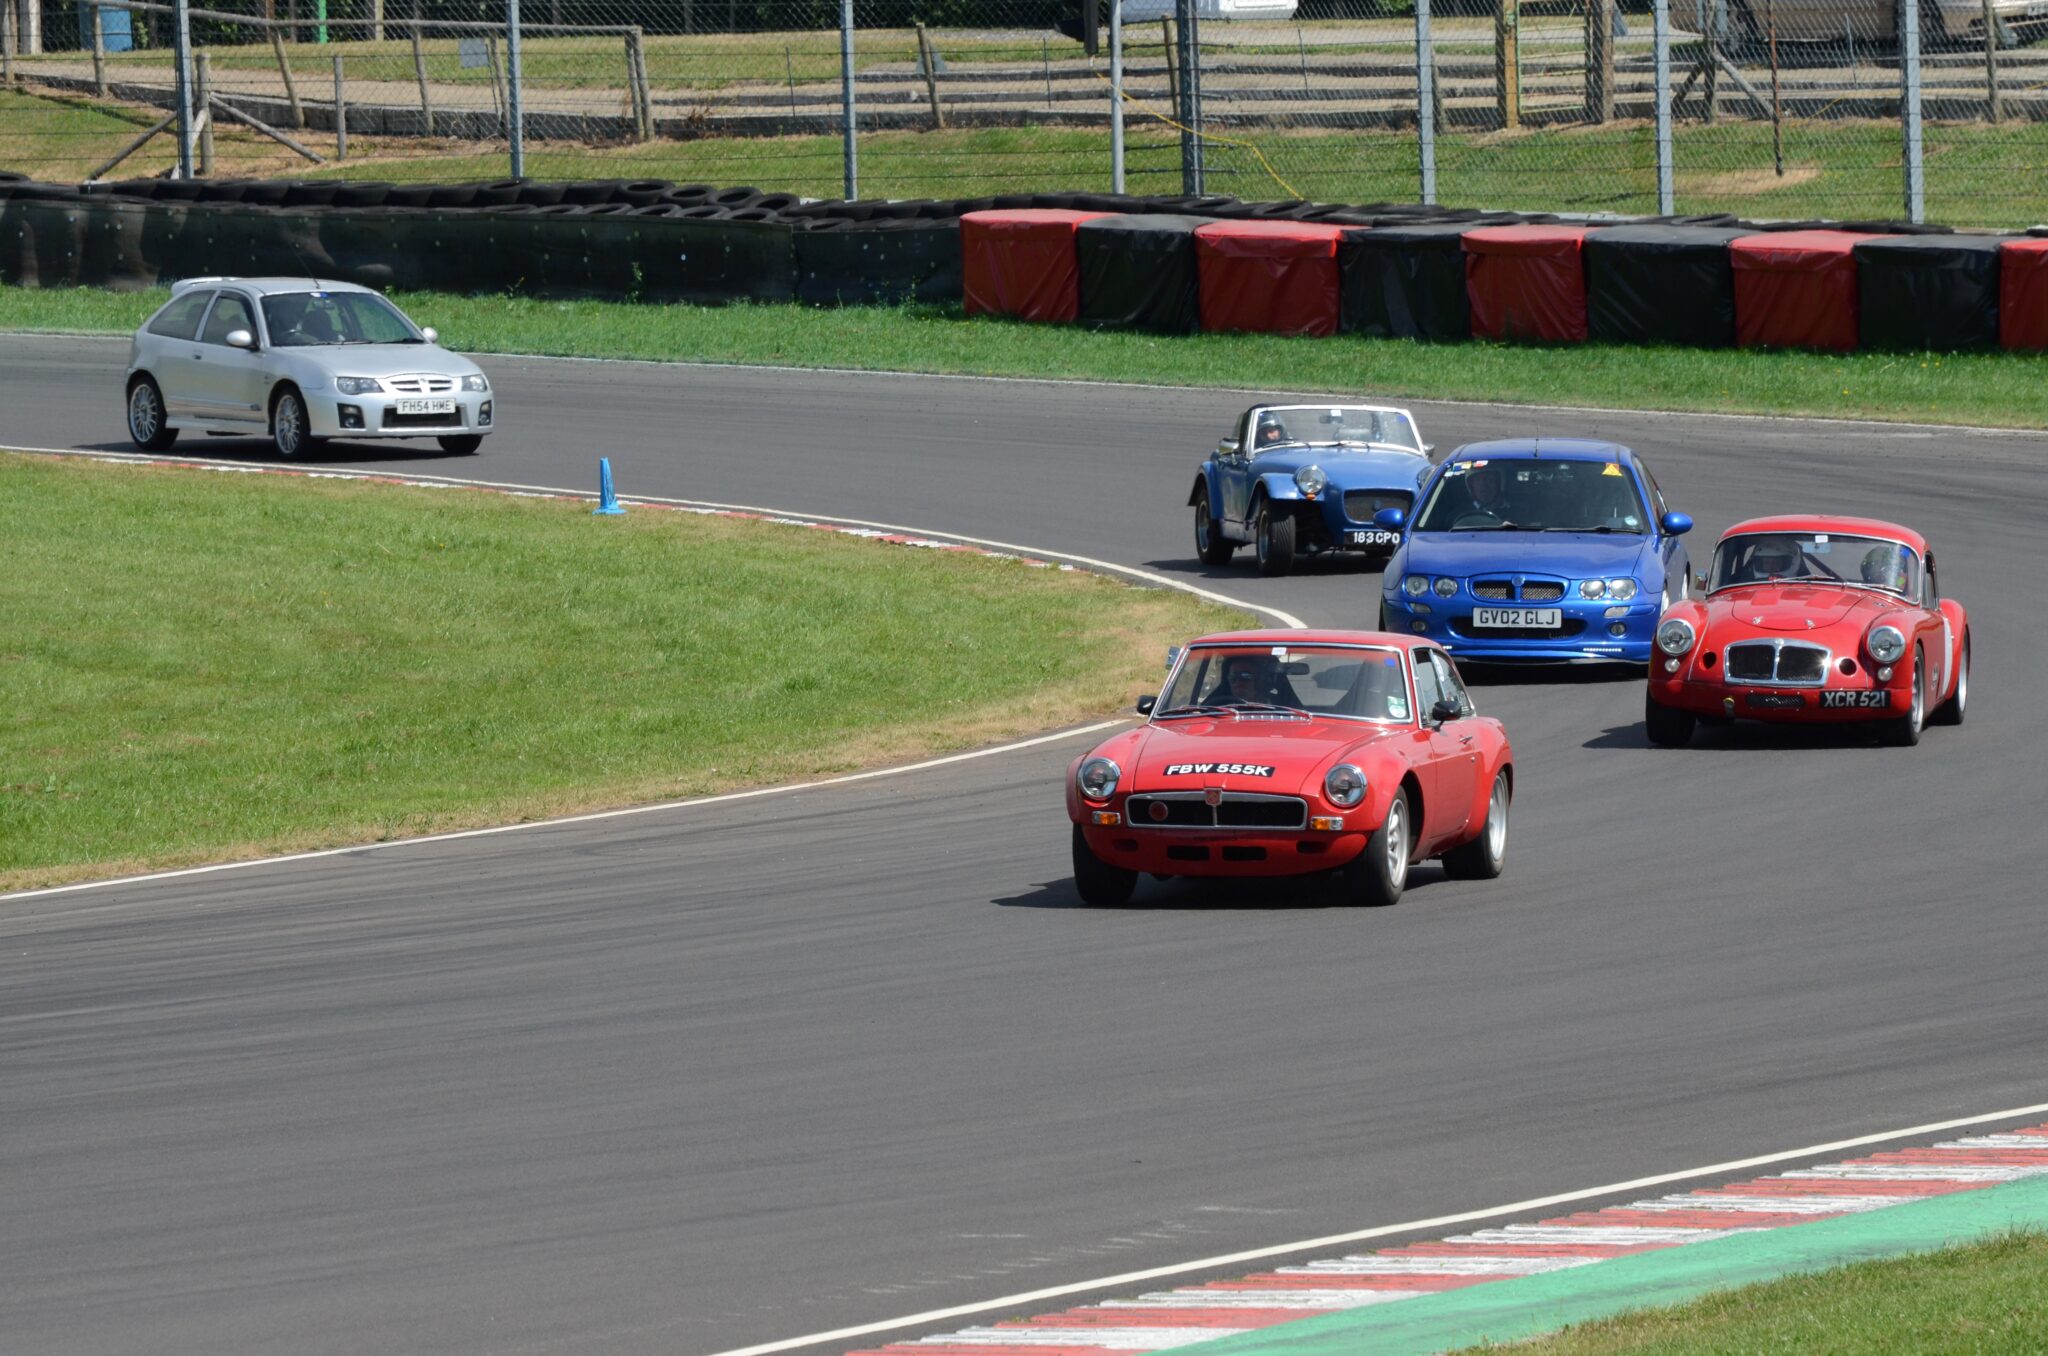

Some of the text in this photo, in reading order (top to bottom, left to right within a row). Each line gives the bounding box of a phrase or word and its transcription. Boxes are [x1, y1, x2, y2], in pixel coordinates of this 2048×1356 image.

[402, 400, 451, 411] FH54 HME
[1354, 532, 1374, 543] 183
[1480, 610, 1554, 625] GV02 GLJ
[1824, 691, 1885, 707] XCR 521
[1167, 764, 1270, 776] FBW 555K
